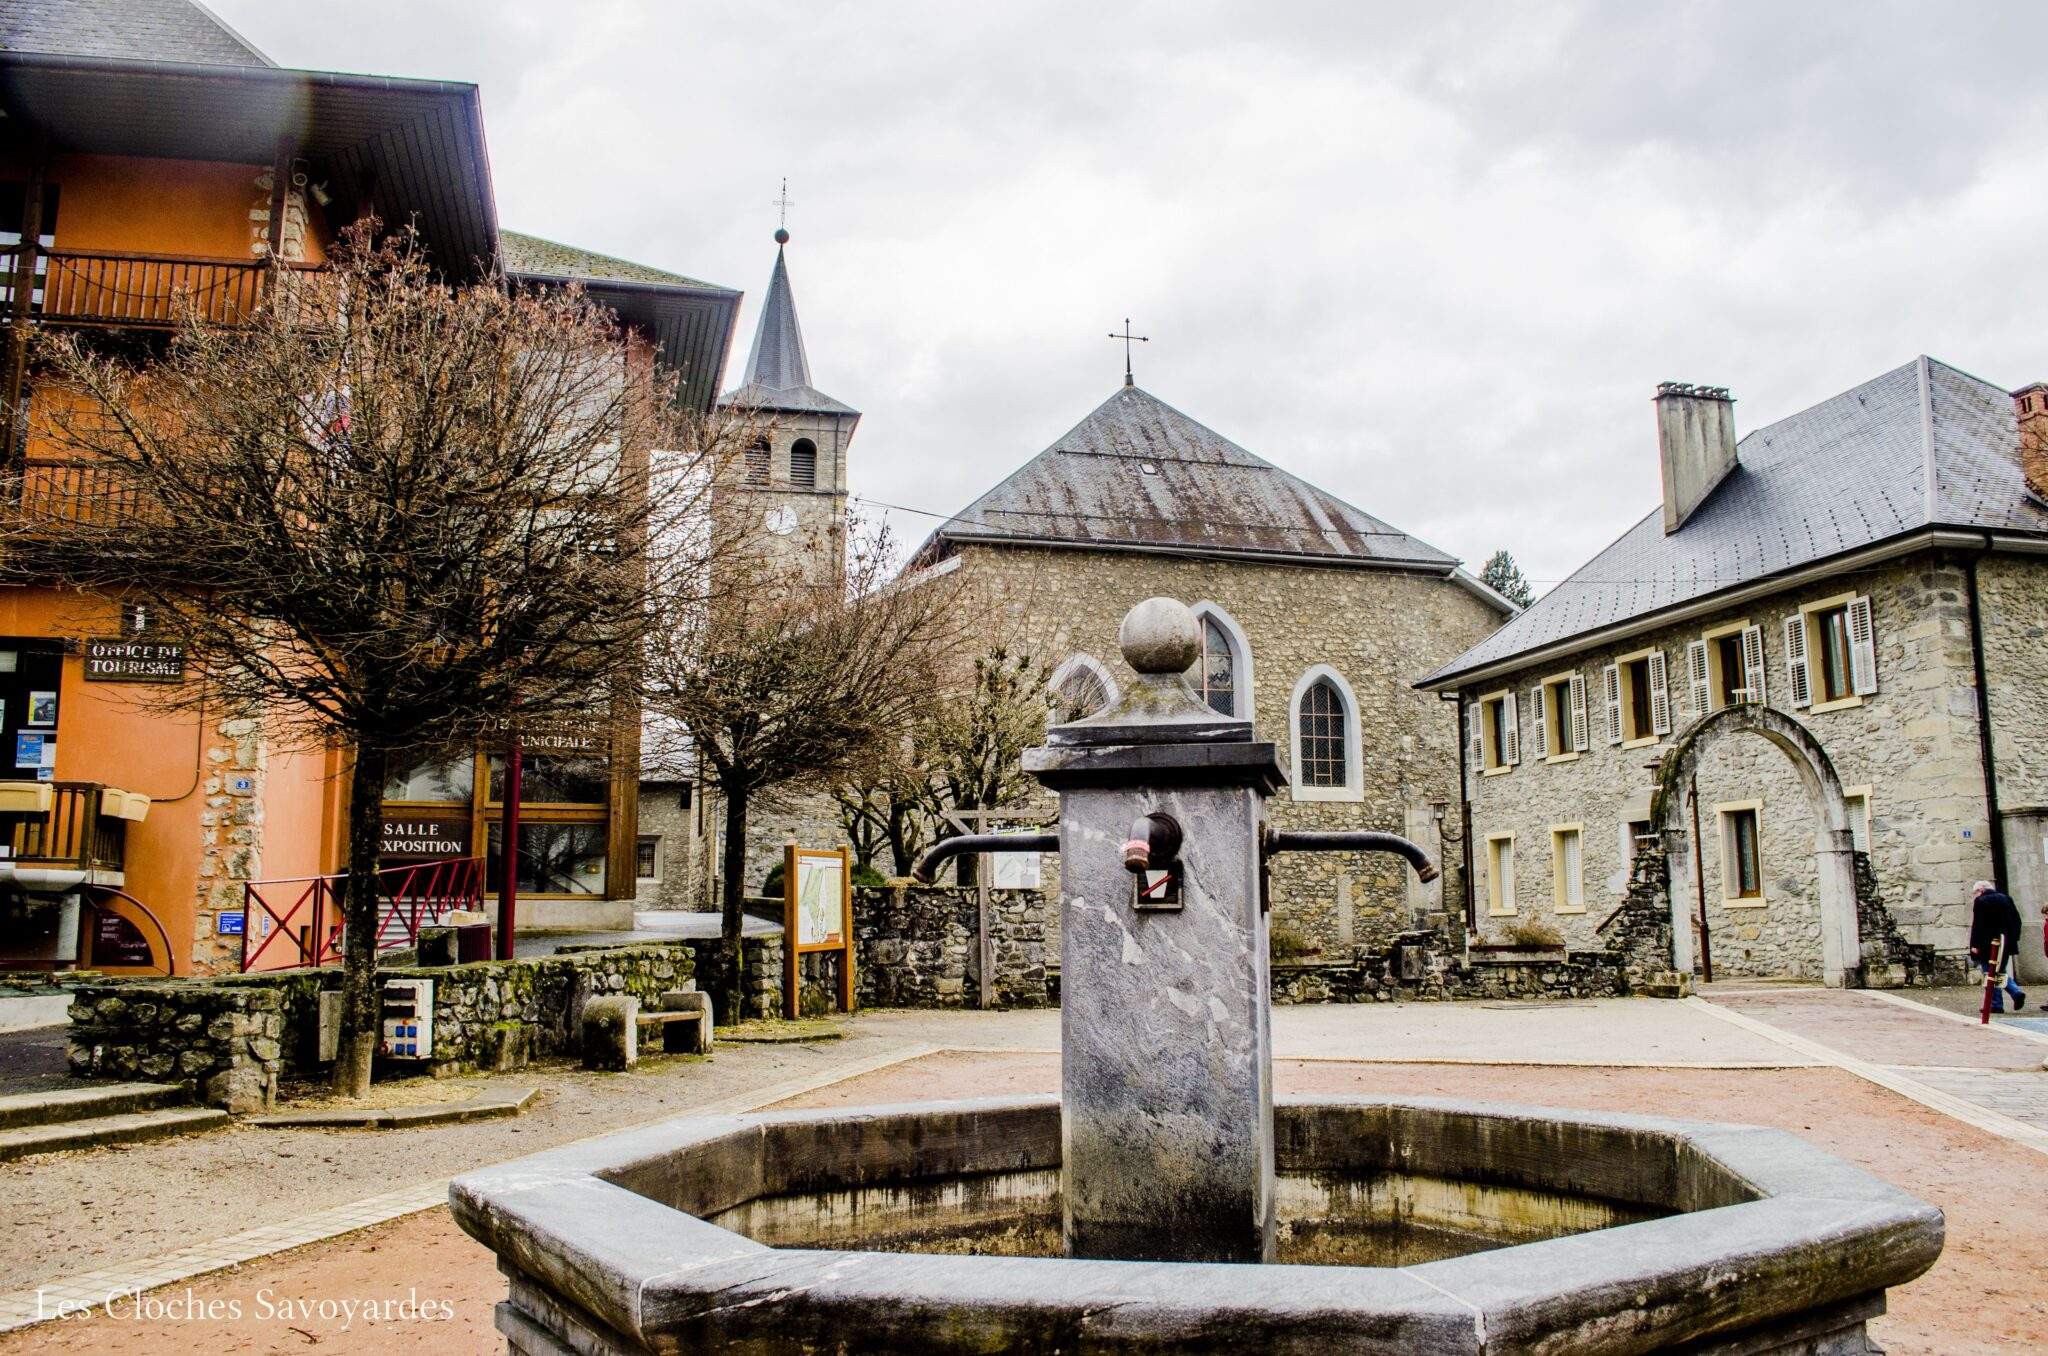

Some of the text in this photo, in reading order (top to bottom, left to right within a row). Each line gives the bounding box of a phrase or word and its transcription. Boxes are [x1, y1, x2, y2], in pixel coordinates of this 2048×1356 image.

[92, 645, 182, 659] OFFICE DE
[91, 659, 180, 675] TOURISME
[520, 735, 591, 748] UNICIPALE
[384, 823, 439, 836] SALLE
[380, 840, 462, 853] XPOSITION
